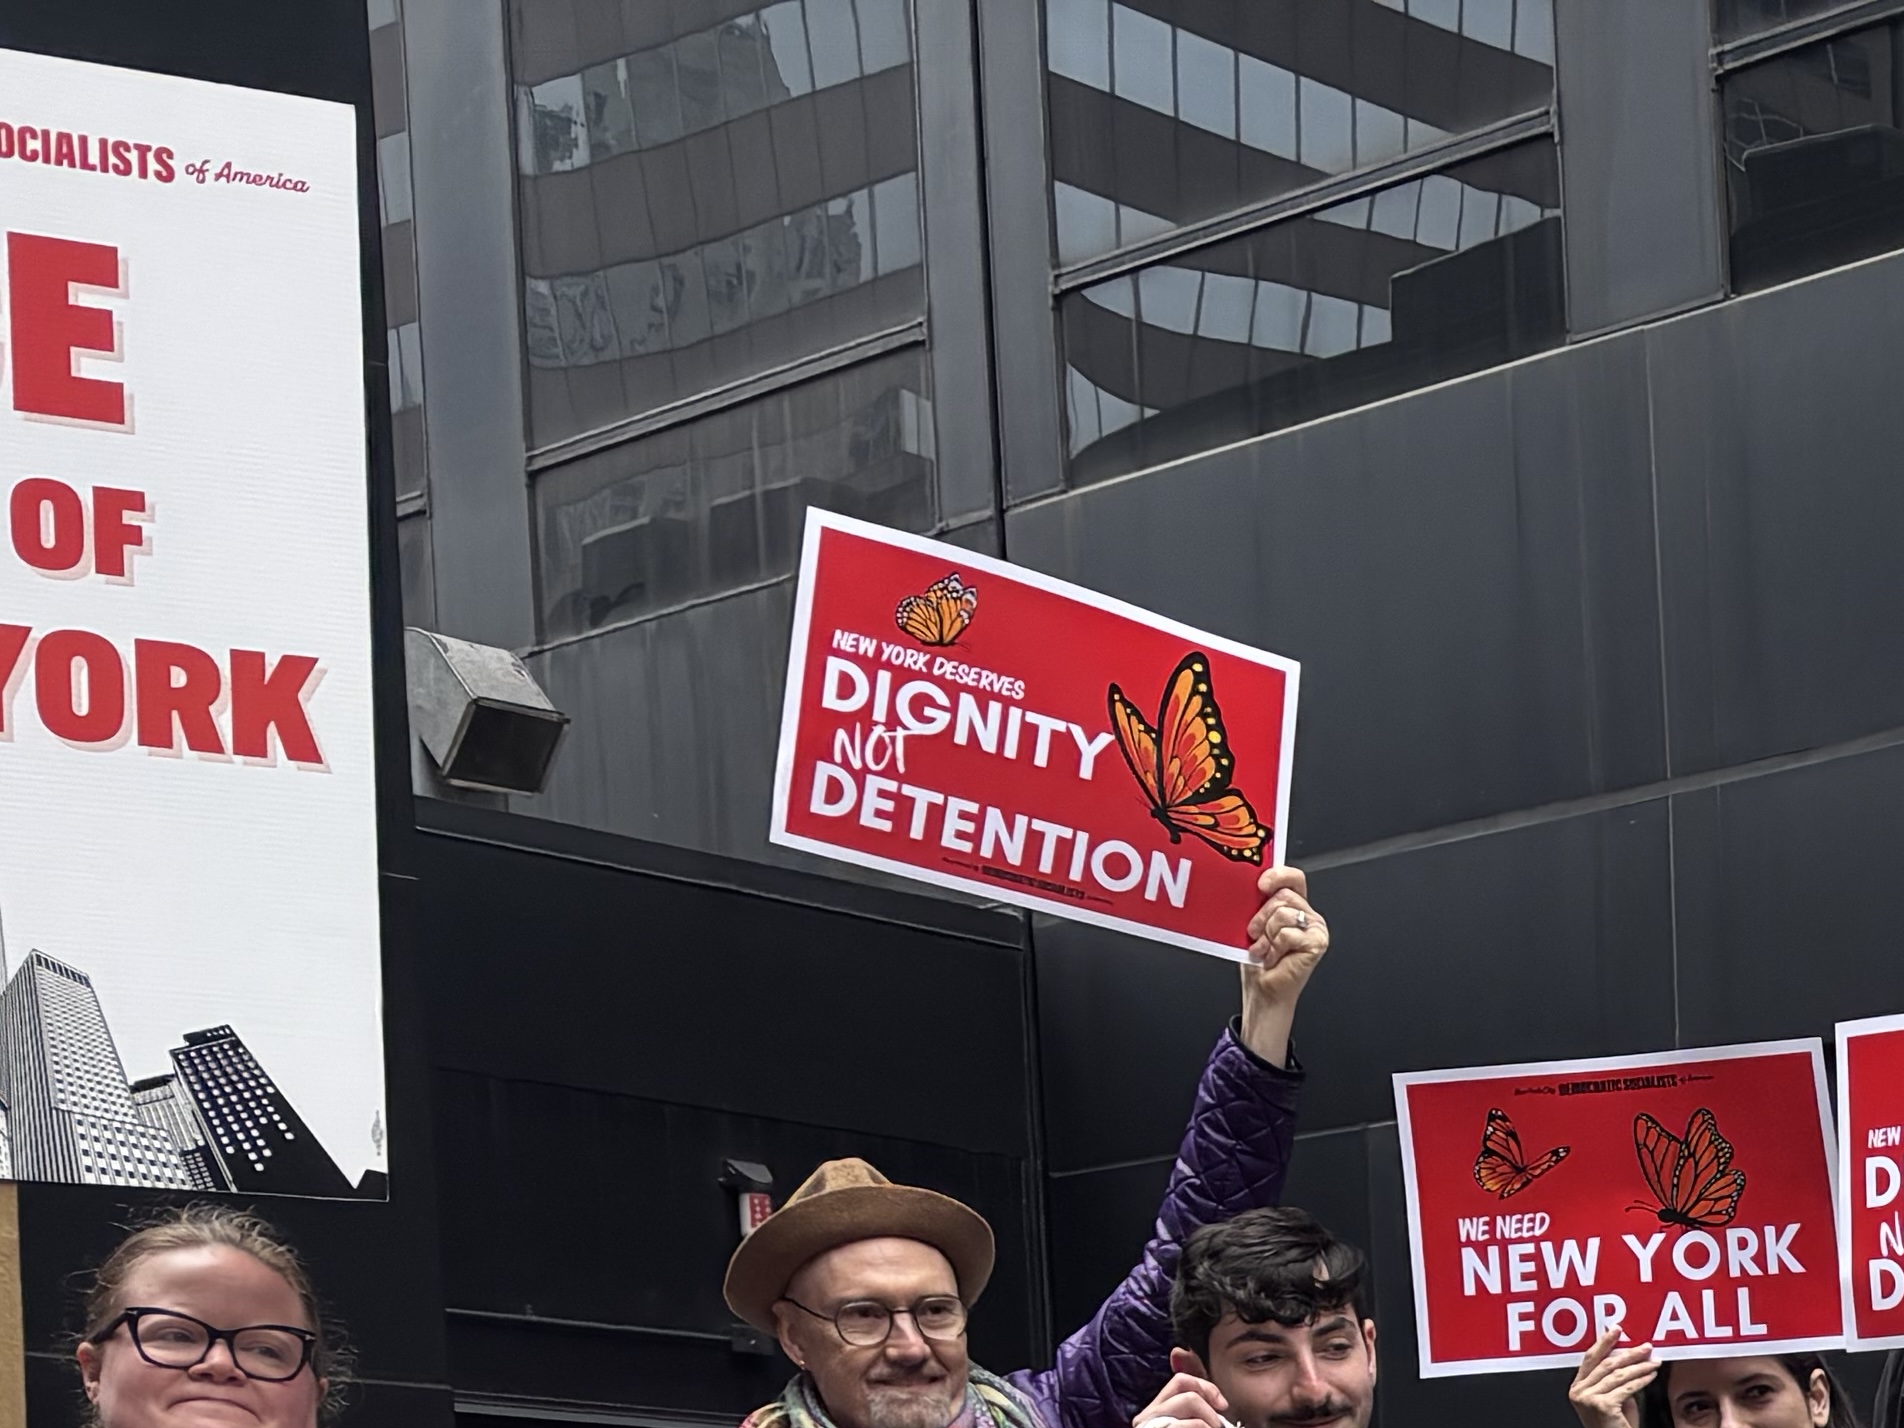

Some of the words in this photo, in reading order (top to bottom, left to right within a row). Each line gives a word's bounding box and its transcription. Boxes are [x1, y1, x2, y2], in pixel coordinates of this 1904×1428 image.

[185, 159, 210, 184] of
[214, 161, 310, 193] America
[7, 231, 125, 425] E
[10, 478, 146, 577] OF
[832, 629, 879, 654] NEW
[881, 641, 929, 673] YORK
[934, 656, 1025, 700] DESERVES
[822, 655, 1116, 781] DIGNITY
[833, 722, 918, 774] NOT
[810, 761, 1191, 908] DETENTION
[1867, 1126, 1901, 1149] NEW
[1458, 1215, 1490, 1242] WE
[1496, 1212, 1550, 1240] NEED
[1461, 1236, 1600, 1296] NEW
[1622, 1222, 1807, 1284] YORK
[1507, 1293, 1631, 1352] FOR
[1652, 1286, 1768, 1341] ALL
